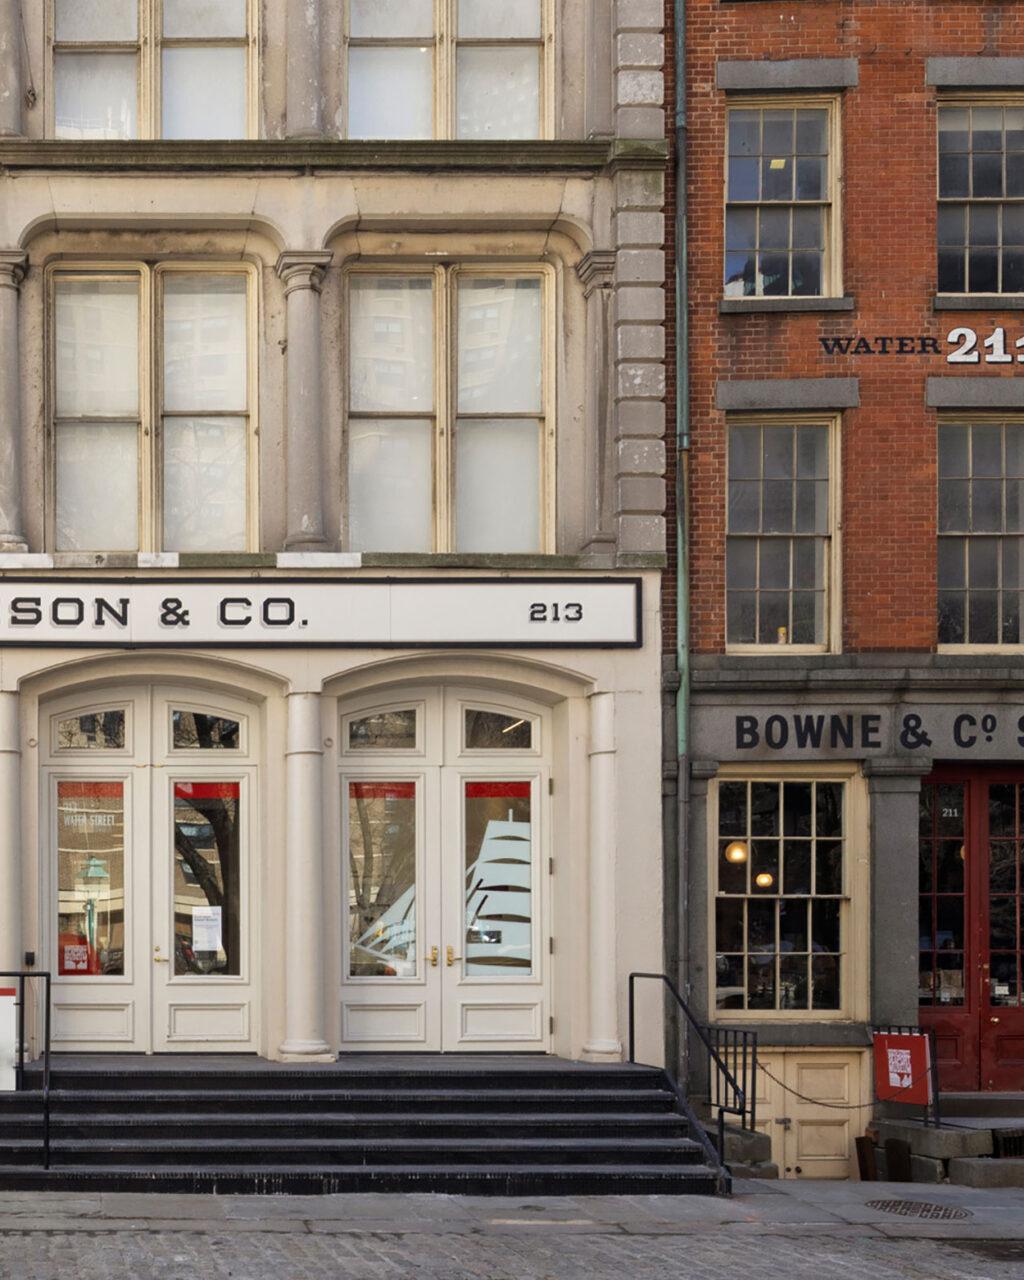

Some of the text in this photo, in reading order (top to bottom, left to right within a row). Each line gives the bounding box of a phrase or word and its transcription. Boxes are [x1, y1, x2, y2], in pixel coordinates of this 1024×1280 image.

[818, 336, 942, 356] WATER
[160, 597, 190, 627] &
[219, 597, 308, 627] CO.
[529, 603, 584, 623] 213
[735, 713, 882, 750] BOWNE
[899, 713, 933, 751] &
[942, 807, 959, 818] 211
